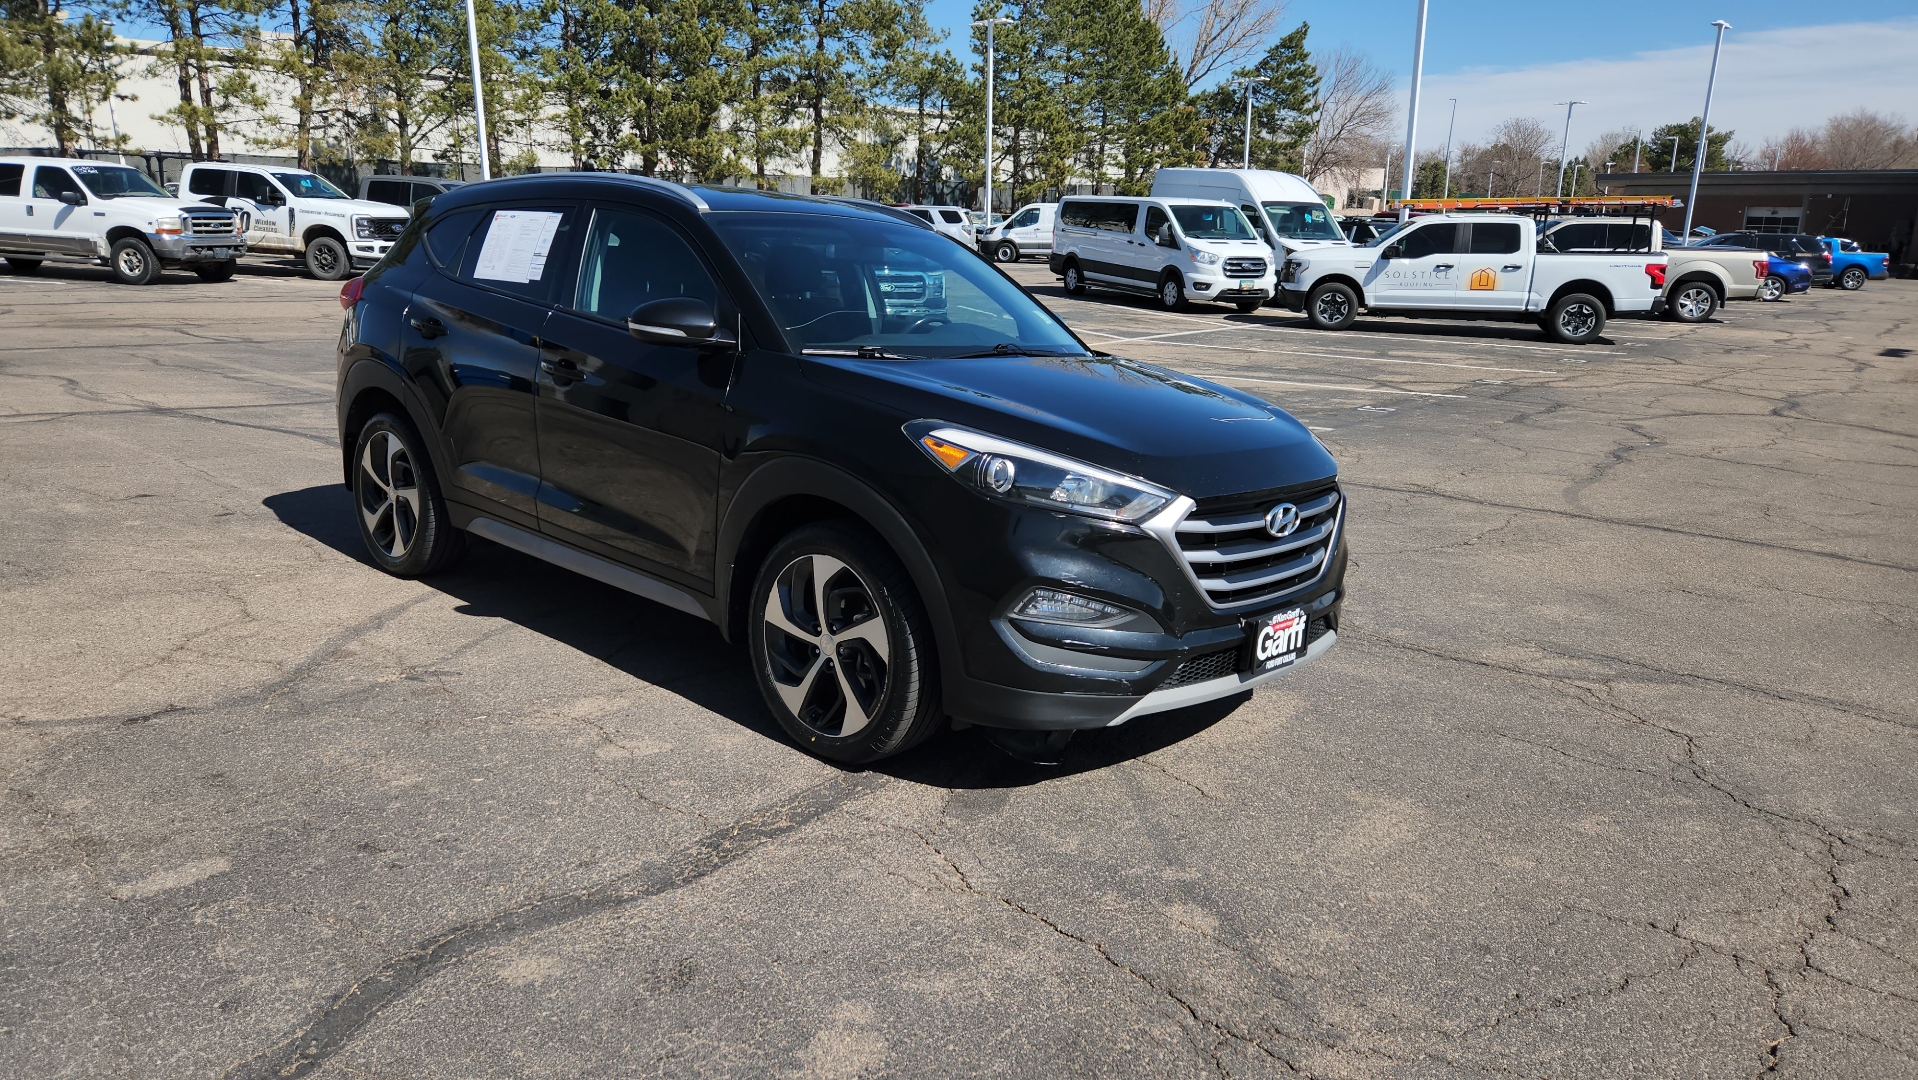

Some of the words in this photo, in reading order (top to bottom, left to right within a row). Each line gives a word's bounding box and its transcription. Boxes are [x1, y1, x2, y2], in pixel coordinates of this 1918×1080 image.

[255, 218, 277, 226] Window
[253, 225, 278, 233] Cleaning
[1384, 270, 1450, 279] SOLSTICE
[1257, 615, 1306, 660] Garff
